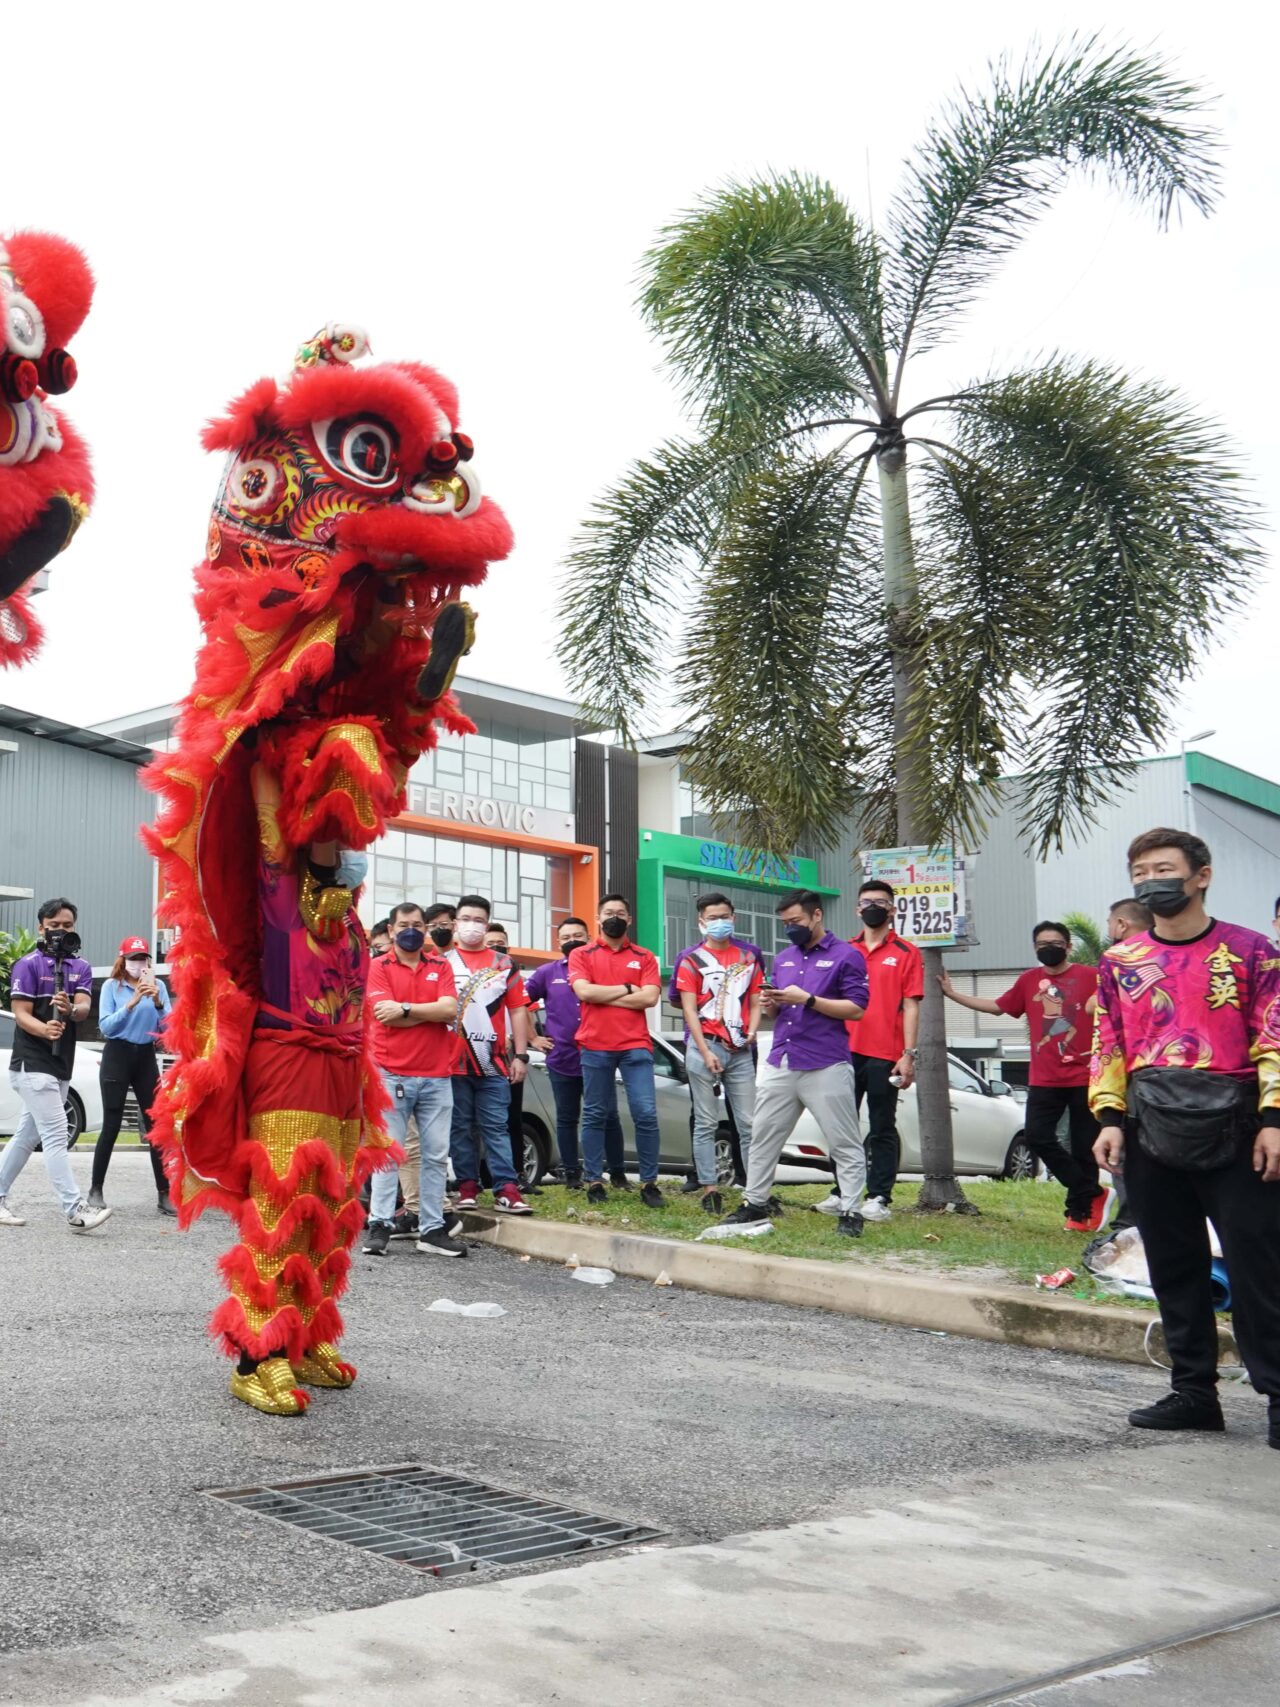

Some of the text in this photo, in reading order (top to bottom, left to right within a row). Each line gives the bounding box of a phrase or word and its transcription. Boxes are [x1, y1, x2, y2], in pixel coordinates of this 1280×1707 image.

[409, 783, 537, 834] FERROVIC
[893, 884, 951, 896] ST LOAN
[897, 896, 930, 913] 019
[912, 910, 953, 935] 5225
[1204, 942, 1244, 1010] 金英
